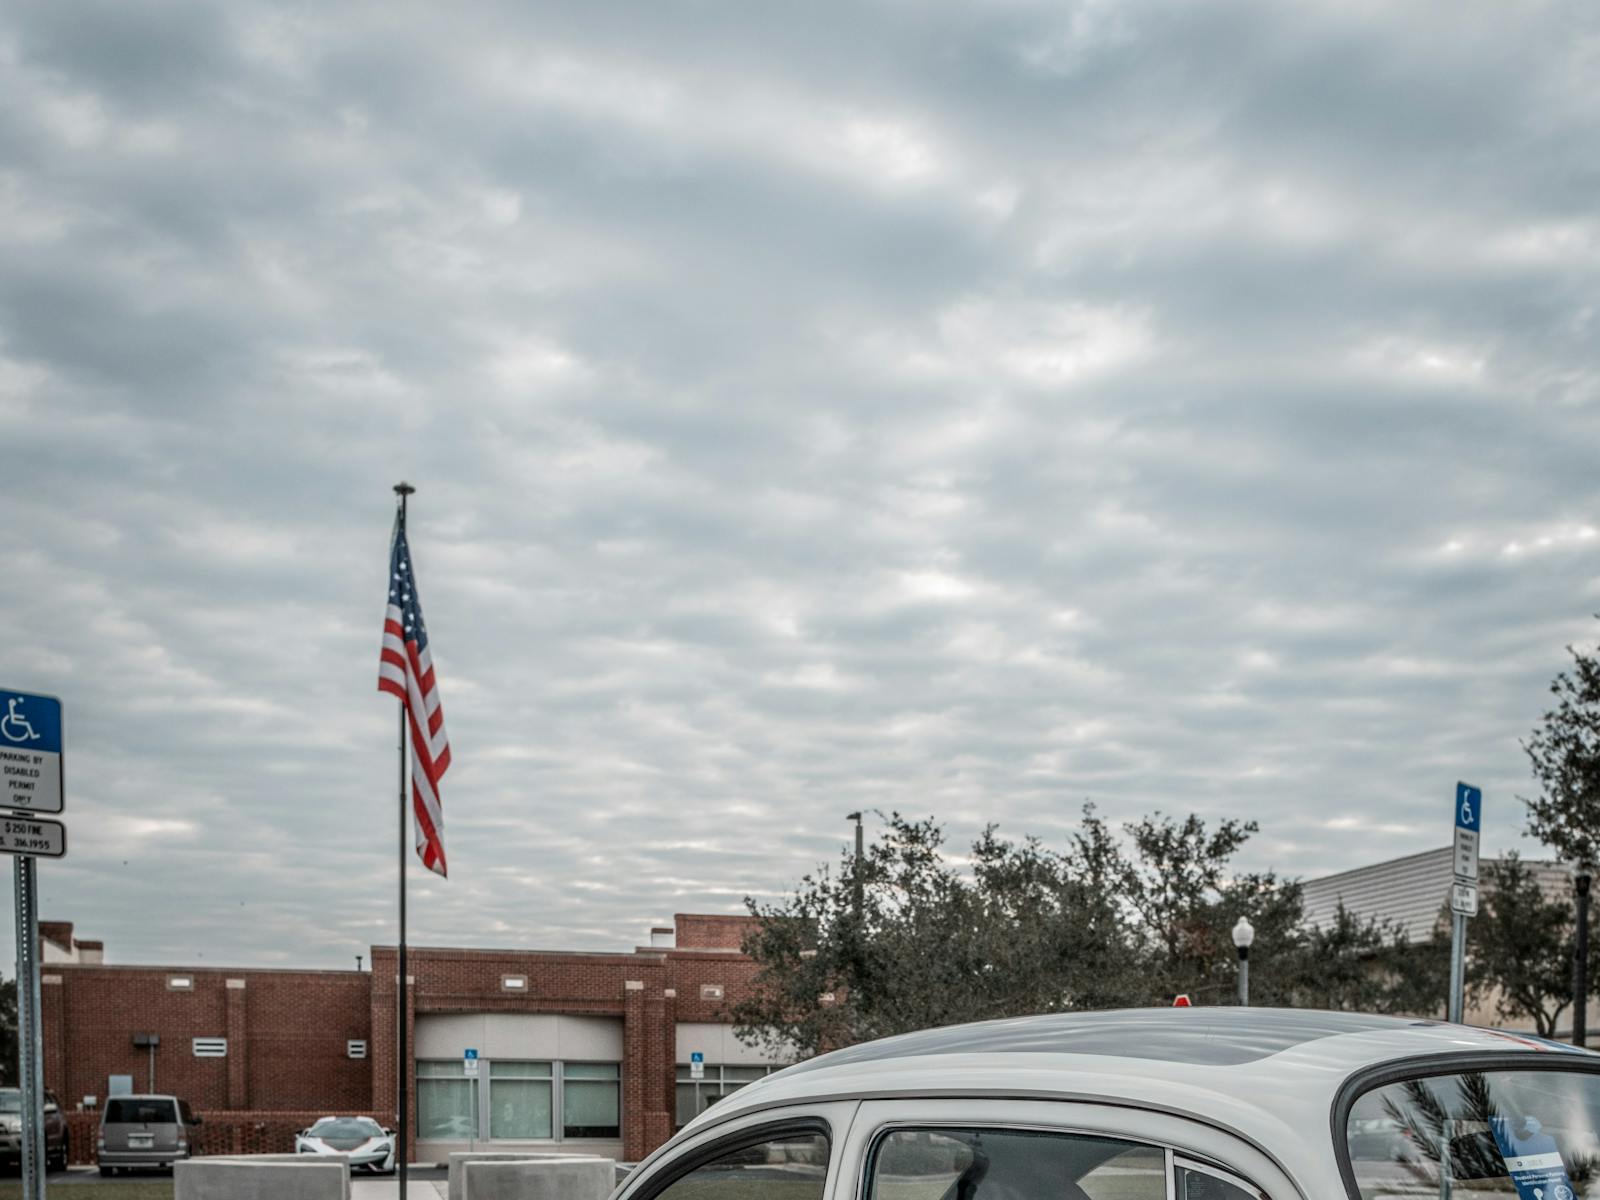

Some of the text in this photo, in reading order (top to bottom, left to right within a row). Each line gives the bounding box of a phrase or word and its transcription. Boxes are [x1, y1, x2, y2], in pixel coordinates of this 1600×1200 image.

[33, 756, 43, 765] BY
[4, 766, 40, 779] DISABLED
[9, 780, 35, 791] PERMIT
